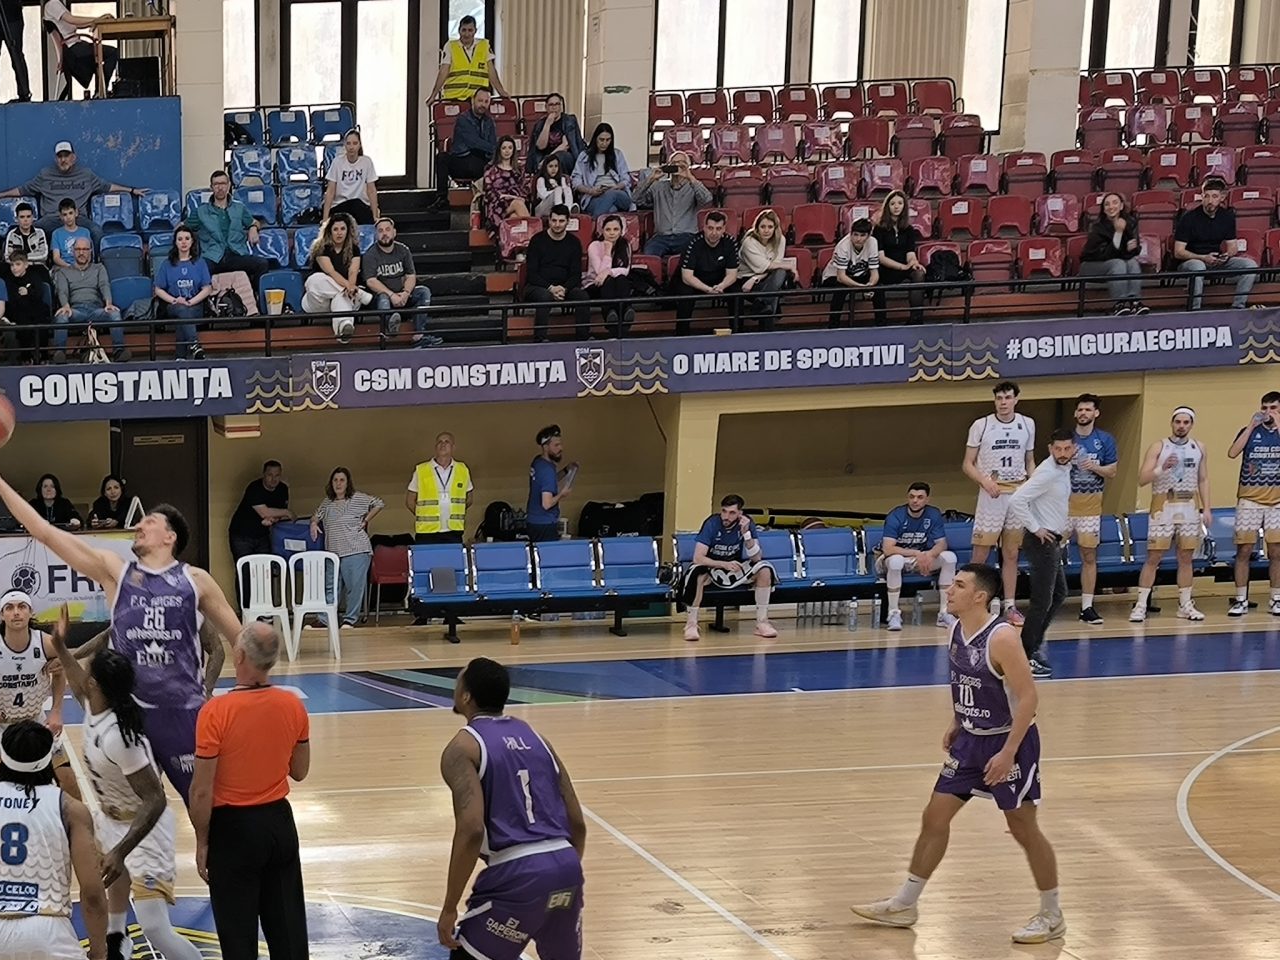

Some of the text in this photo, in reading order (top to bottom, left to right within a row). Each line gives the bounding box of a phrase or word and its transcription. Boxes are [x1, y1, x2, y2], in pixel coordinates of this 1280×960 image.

[1006, 326, 1233, 360] #OSINGURAECHIPA
[672, 344, 905, 375] O MARE DE SPORTIVI
[19, 366, 233, 407] CONSTANȚA
[354, 360, 568, 392] CSM CONSTANȚA
[1000, 456, 1012, 467] 11
[143, 606, 165, 631] 26
[12, 692, 26, 707] 4
[957, 684, 974, 706] 10
[516, 769, 536, 824] 1
[0, 822, 29, 866] 8
